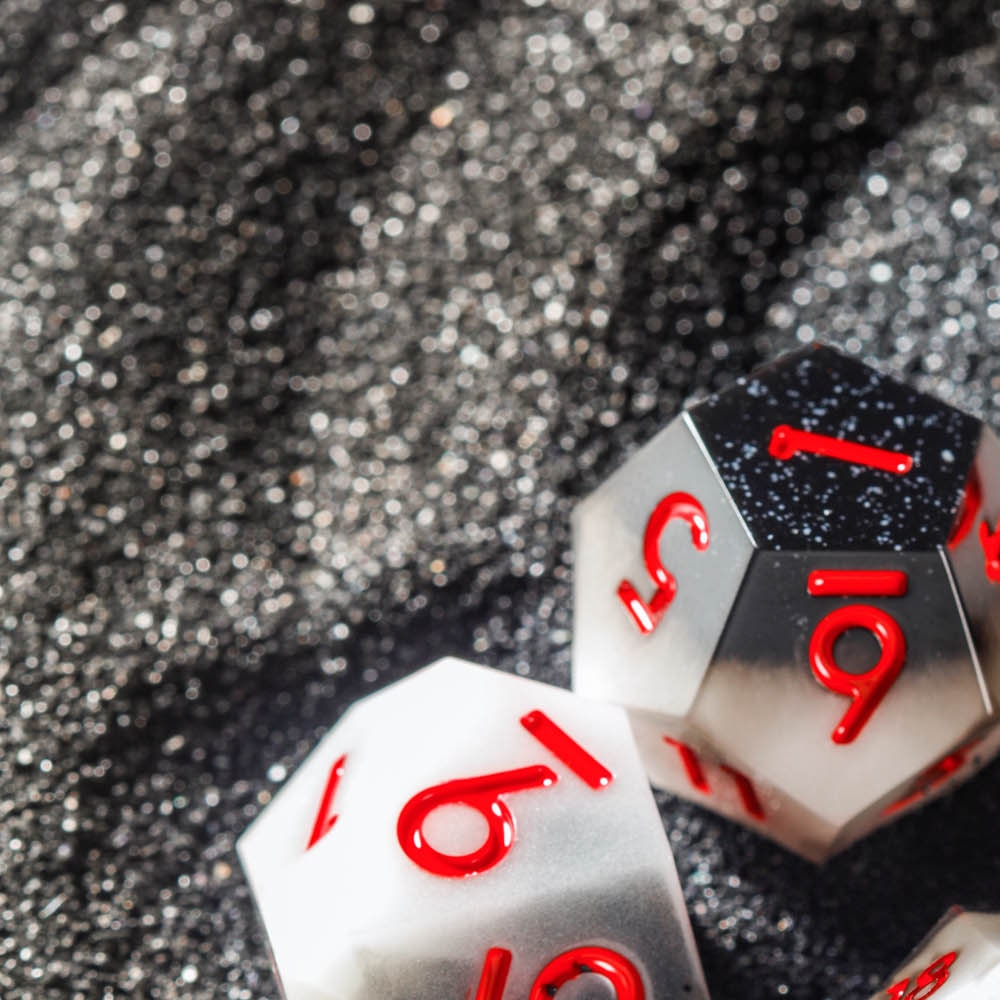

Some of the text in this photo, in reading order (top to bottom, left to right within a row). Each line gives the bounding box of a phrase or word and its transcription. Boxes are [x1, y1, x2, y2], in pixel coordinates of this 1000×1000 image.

[768, 424, 912, 475] 1
[614, 491, 711, 636] 5
[306, 753, 346, 850] 1
